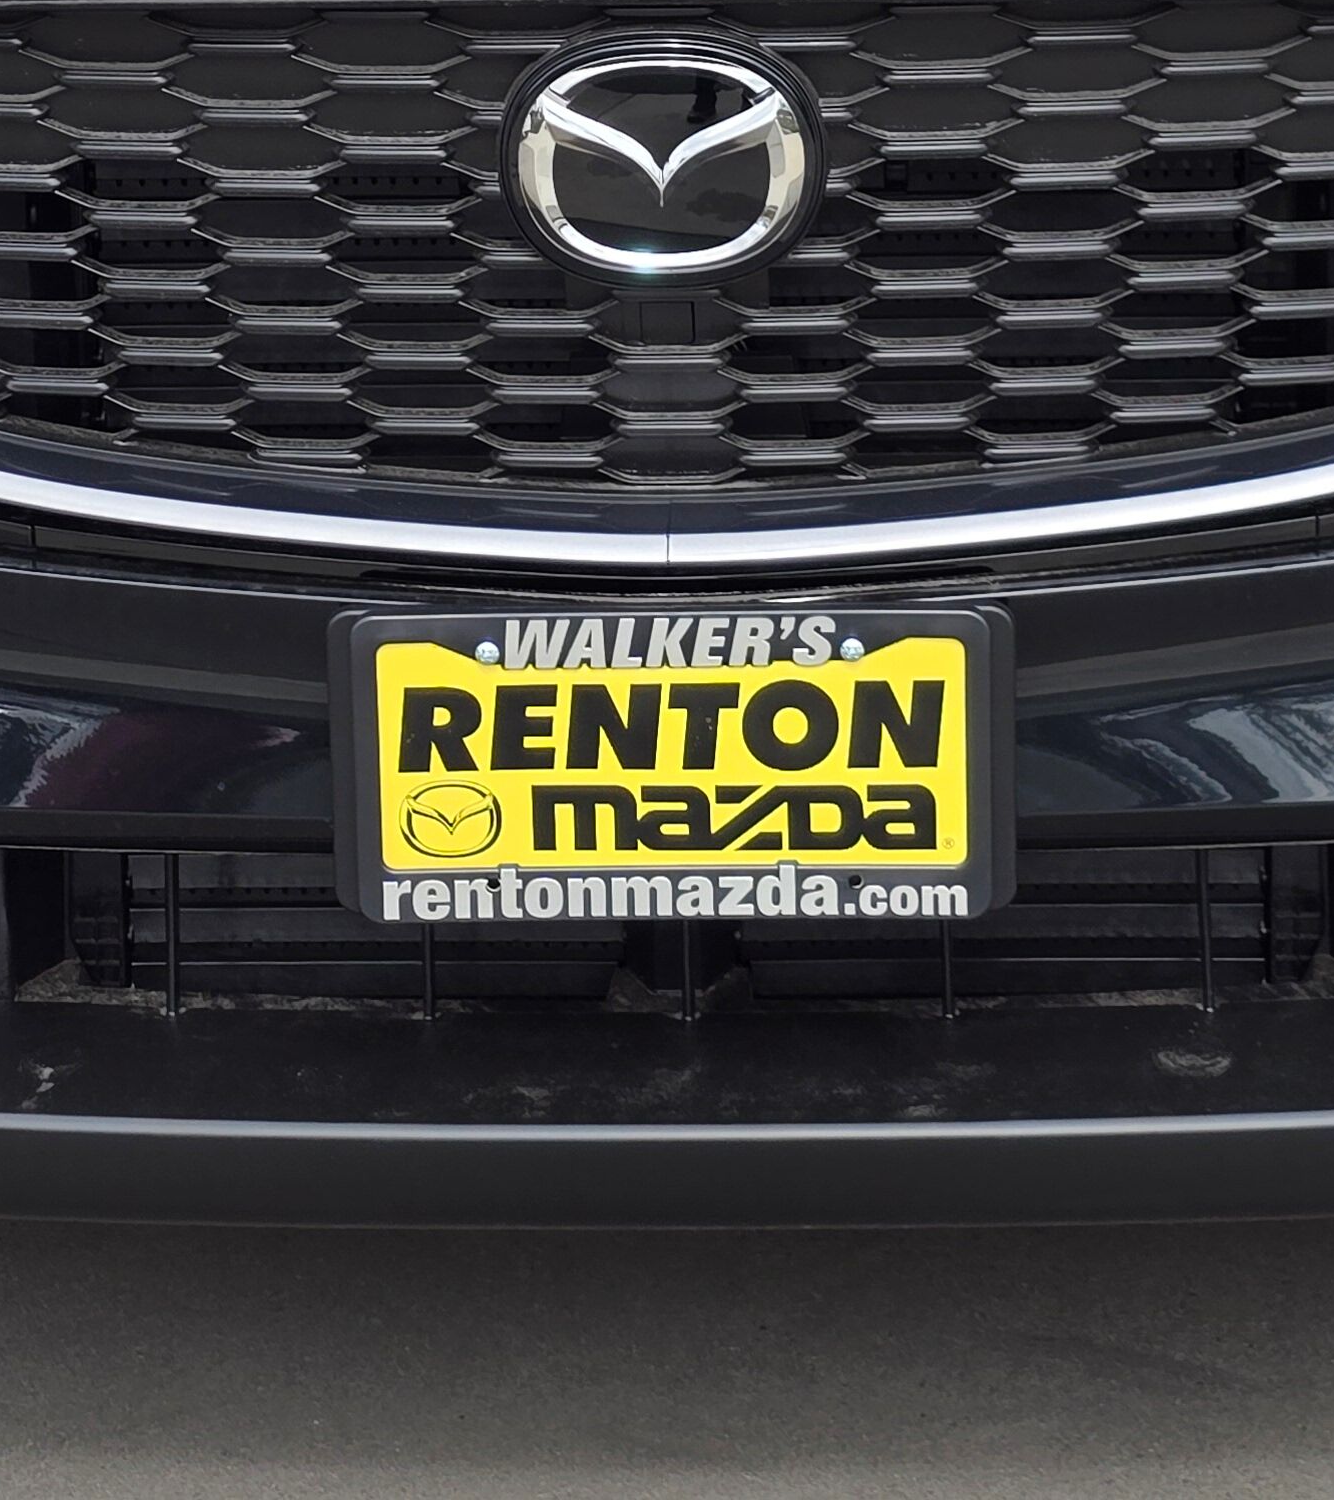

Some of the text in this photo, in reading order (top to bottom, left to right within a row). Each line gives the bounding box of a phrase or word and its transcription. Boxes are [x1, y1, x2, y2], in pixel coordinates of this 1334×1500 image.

[503, 615, 837, 670] WALKER'S
[398, 679, 946, 774] RENTON
[532, 784, 937, 851] mazda
[381, 864, 969, 921] rentonmazda.com
